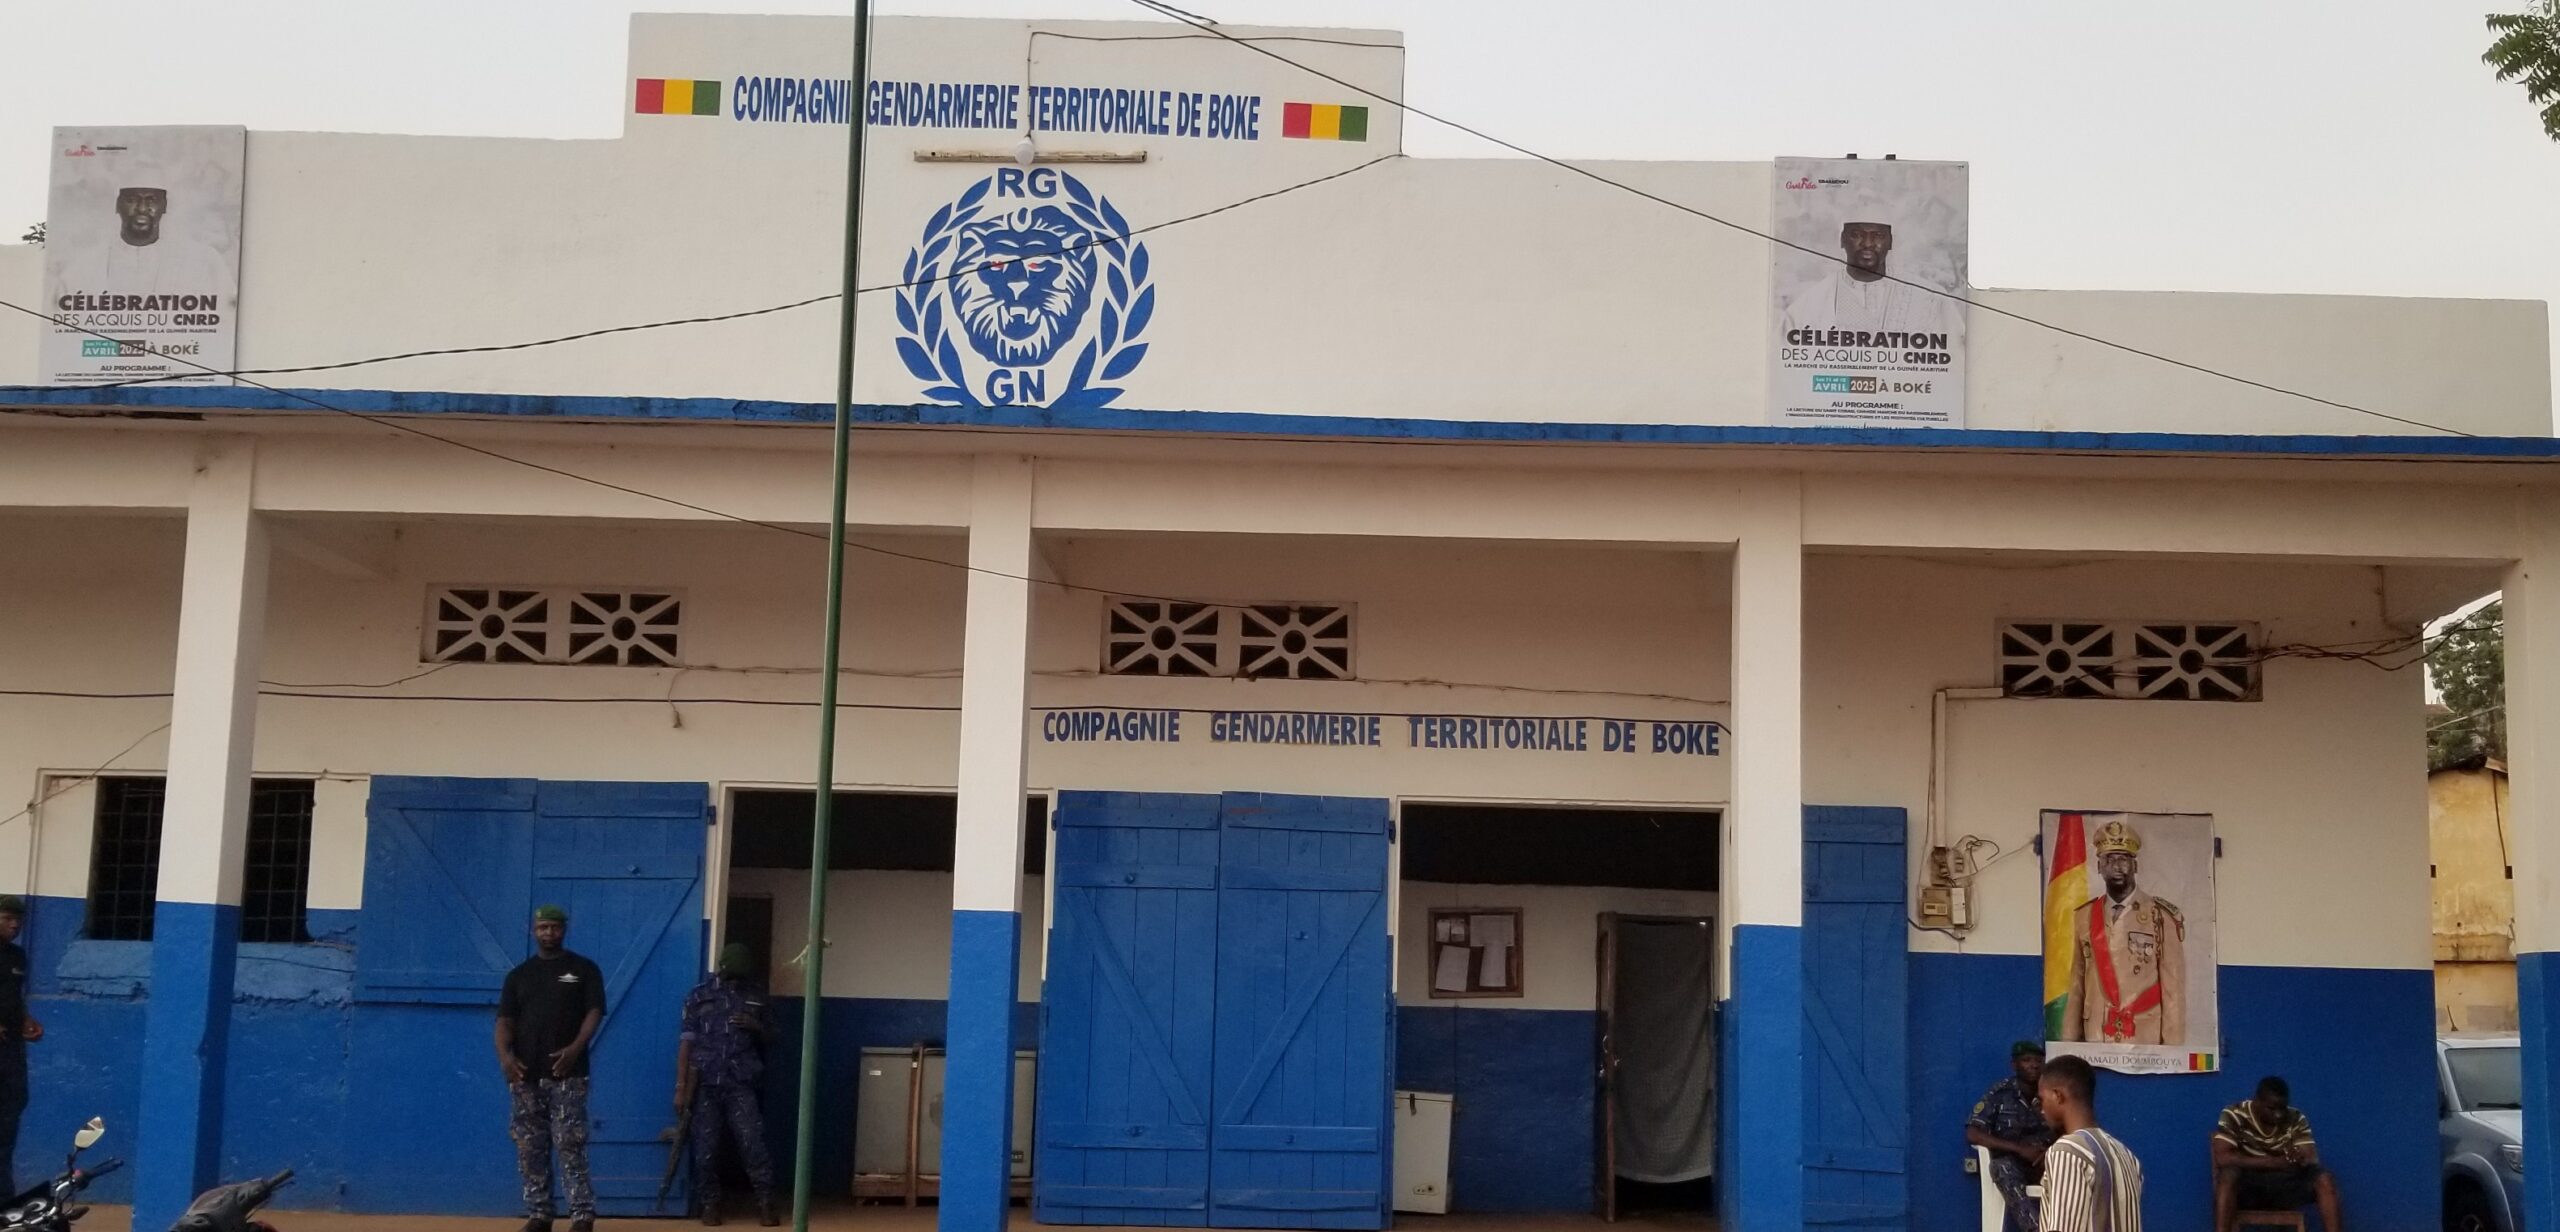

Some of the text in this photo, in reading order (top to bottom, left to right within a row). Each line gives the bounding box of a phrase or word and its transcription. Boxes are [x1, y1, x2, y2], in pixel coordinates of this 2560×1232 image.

[866, 79, 1020, 130] GENDARMERIE
[1028, 85, 1172, 136] TERRITORIALE
[1176, 92, 1204, 138] DE
[1207, 94, 1262, 141] BOKE
[997, 167, 1058, 200] RG
[58, 290, 218, 312] CÉLÉBRATION
[53, 313, 221, 327] DES ACQUIS DU CNRD
[84, 347, 117, 356] AVRIL
[162, 341, 200, 355] BOKÉ
[1786, 325, 1948, 350] CÉLÉBRATION
[1782, 348, 1951, 365] DES ACQUIS DU CNRD
[985, 367, 1046, 404] GN
[1815, 378, 1932, 394] AVRIL 2025 À BOKÉ
[1831, 401, 1844, 409] AU
[1845, 401, 1900, 410] PROGRAMME
[1043, 710, 1720, 757] COMPAGNIE GENDARMERIE TERRITORIALE DE BOKE
